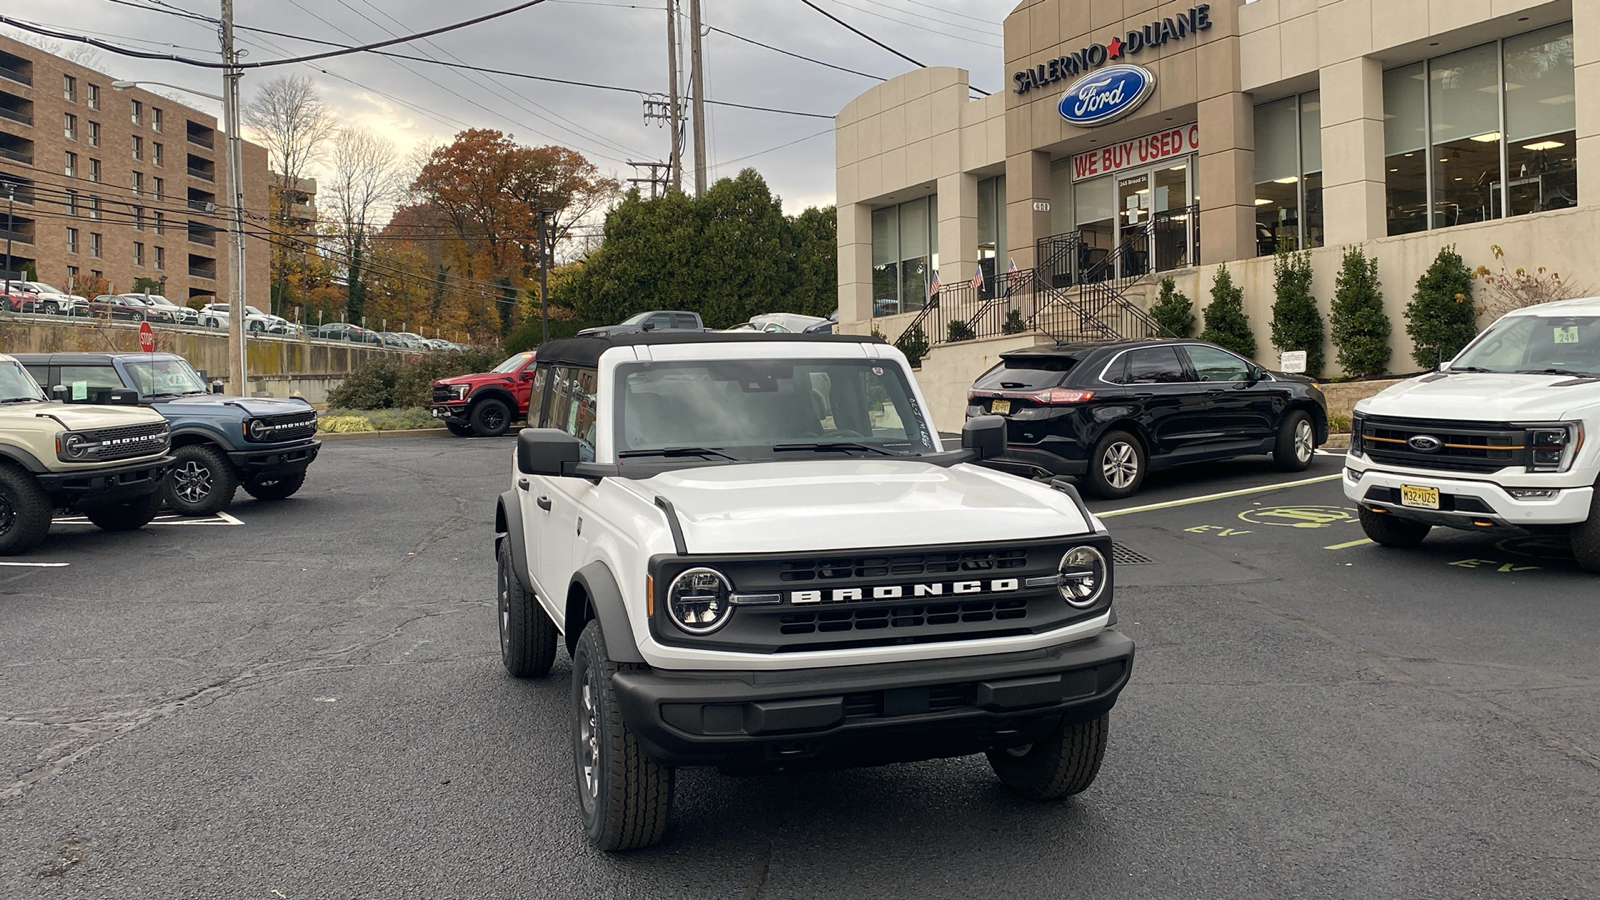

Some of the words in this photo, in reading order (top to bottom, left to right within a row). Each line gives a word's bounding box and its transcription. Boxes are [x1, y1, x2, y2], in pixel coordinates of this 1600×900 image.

[1012, 43, 1107, 94] SALERNO
[1125, 3, 1213, 54] DUANE
[1074, 78, 1125, 116] Ford
[1074, 153, 1097, 178] WE
[1102, 141, 1134, 171] BUY
[1138, 130, 1183, 164] USED
[141, 332, 153, 345] STOP
[1559, 333, 1575, 342] 249
[1282, 354, 1304, 362] CUSTOMER
[275, 421, 310, 430] BRONCO
[102, 435, 156, 446] BRONCO
[1184, 525, 1253, 537] EV
[1448, 558, 1541, 573] EV
[790, 578, 1019, 605] BRONCO
